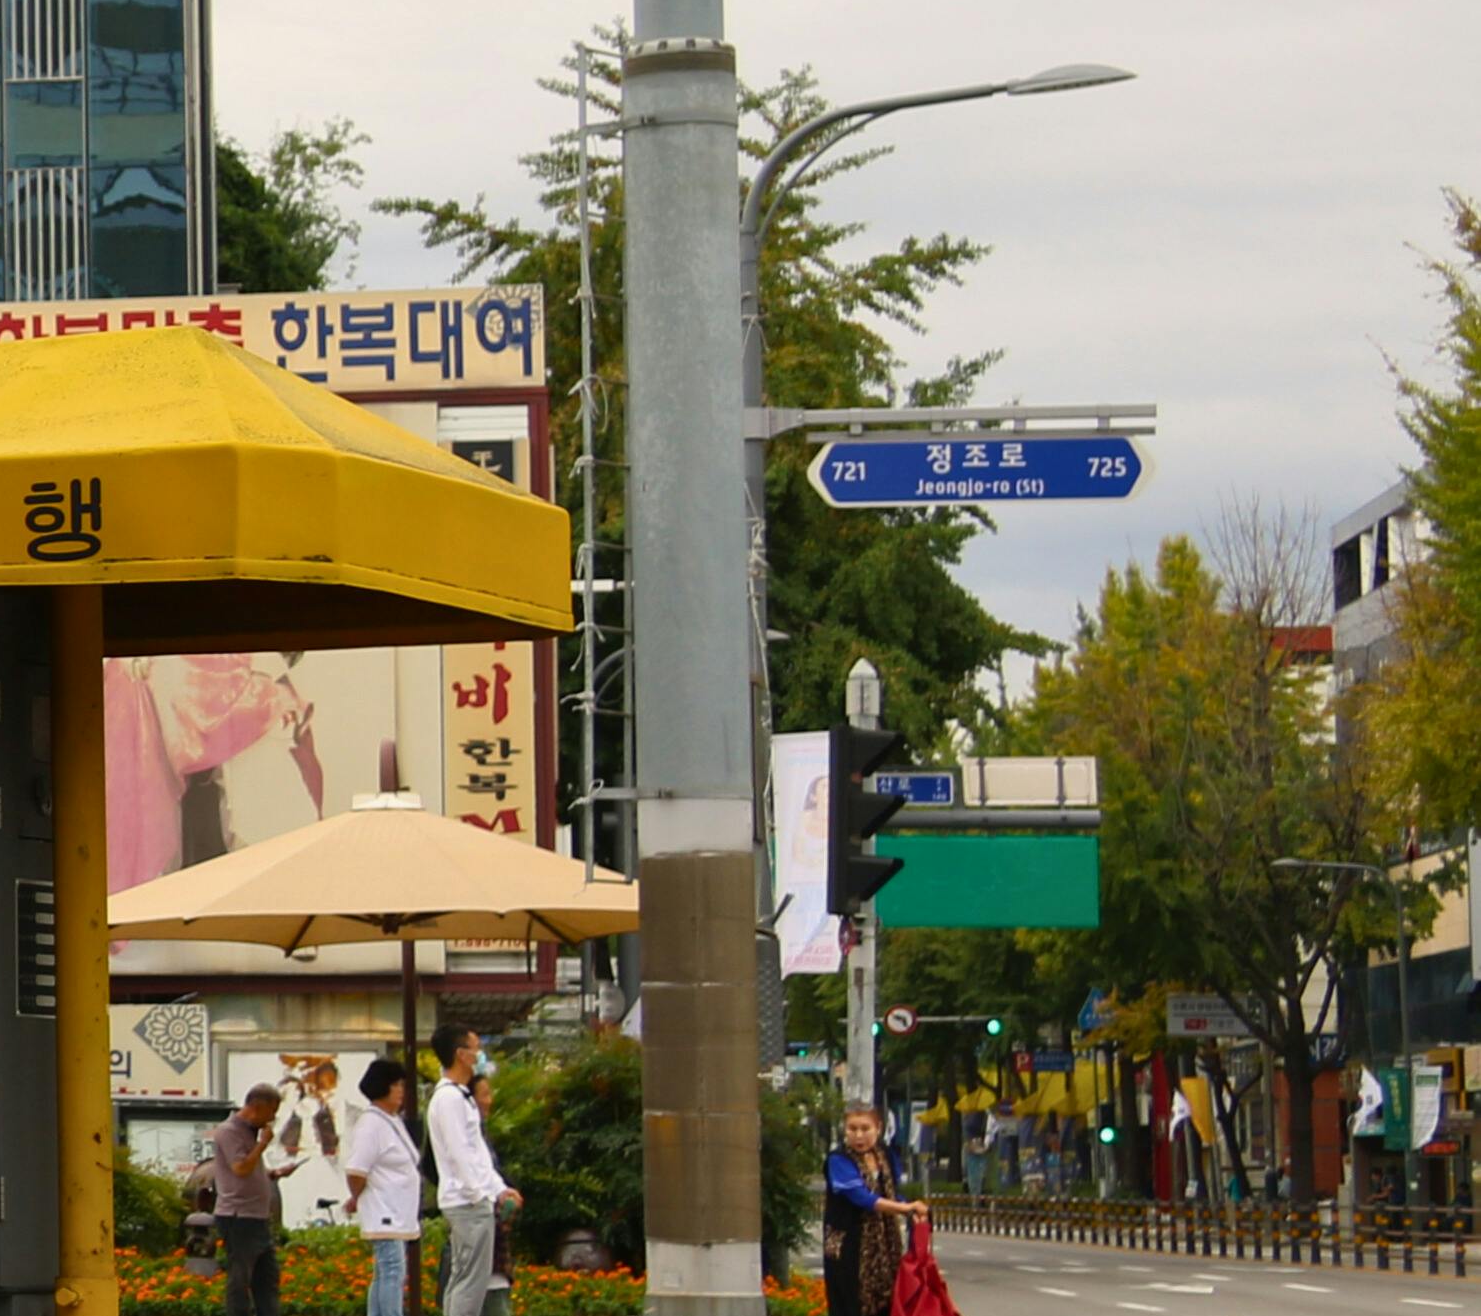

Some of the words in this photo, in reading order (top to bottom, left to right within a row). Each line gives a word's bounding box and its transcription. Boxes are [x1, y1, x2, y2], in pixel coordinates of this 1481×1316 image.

[270, 296, 533, 383] 한복대여
[926, 443, 1027, 475] 정조로
[1087, 456, 1128, 478] 725
[831, 461, 866, 482] 721
[915, 478, 1010, 497] Jeongjo-ro
[1016, 478, 1045, 496] (St)
